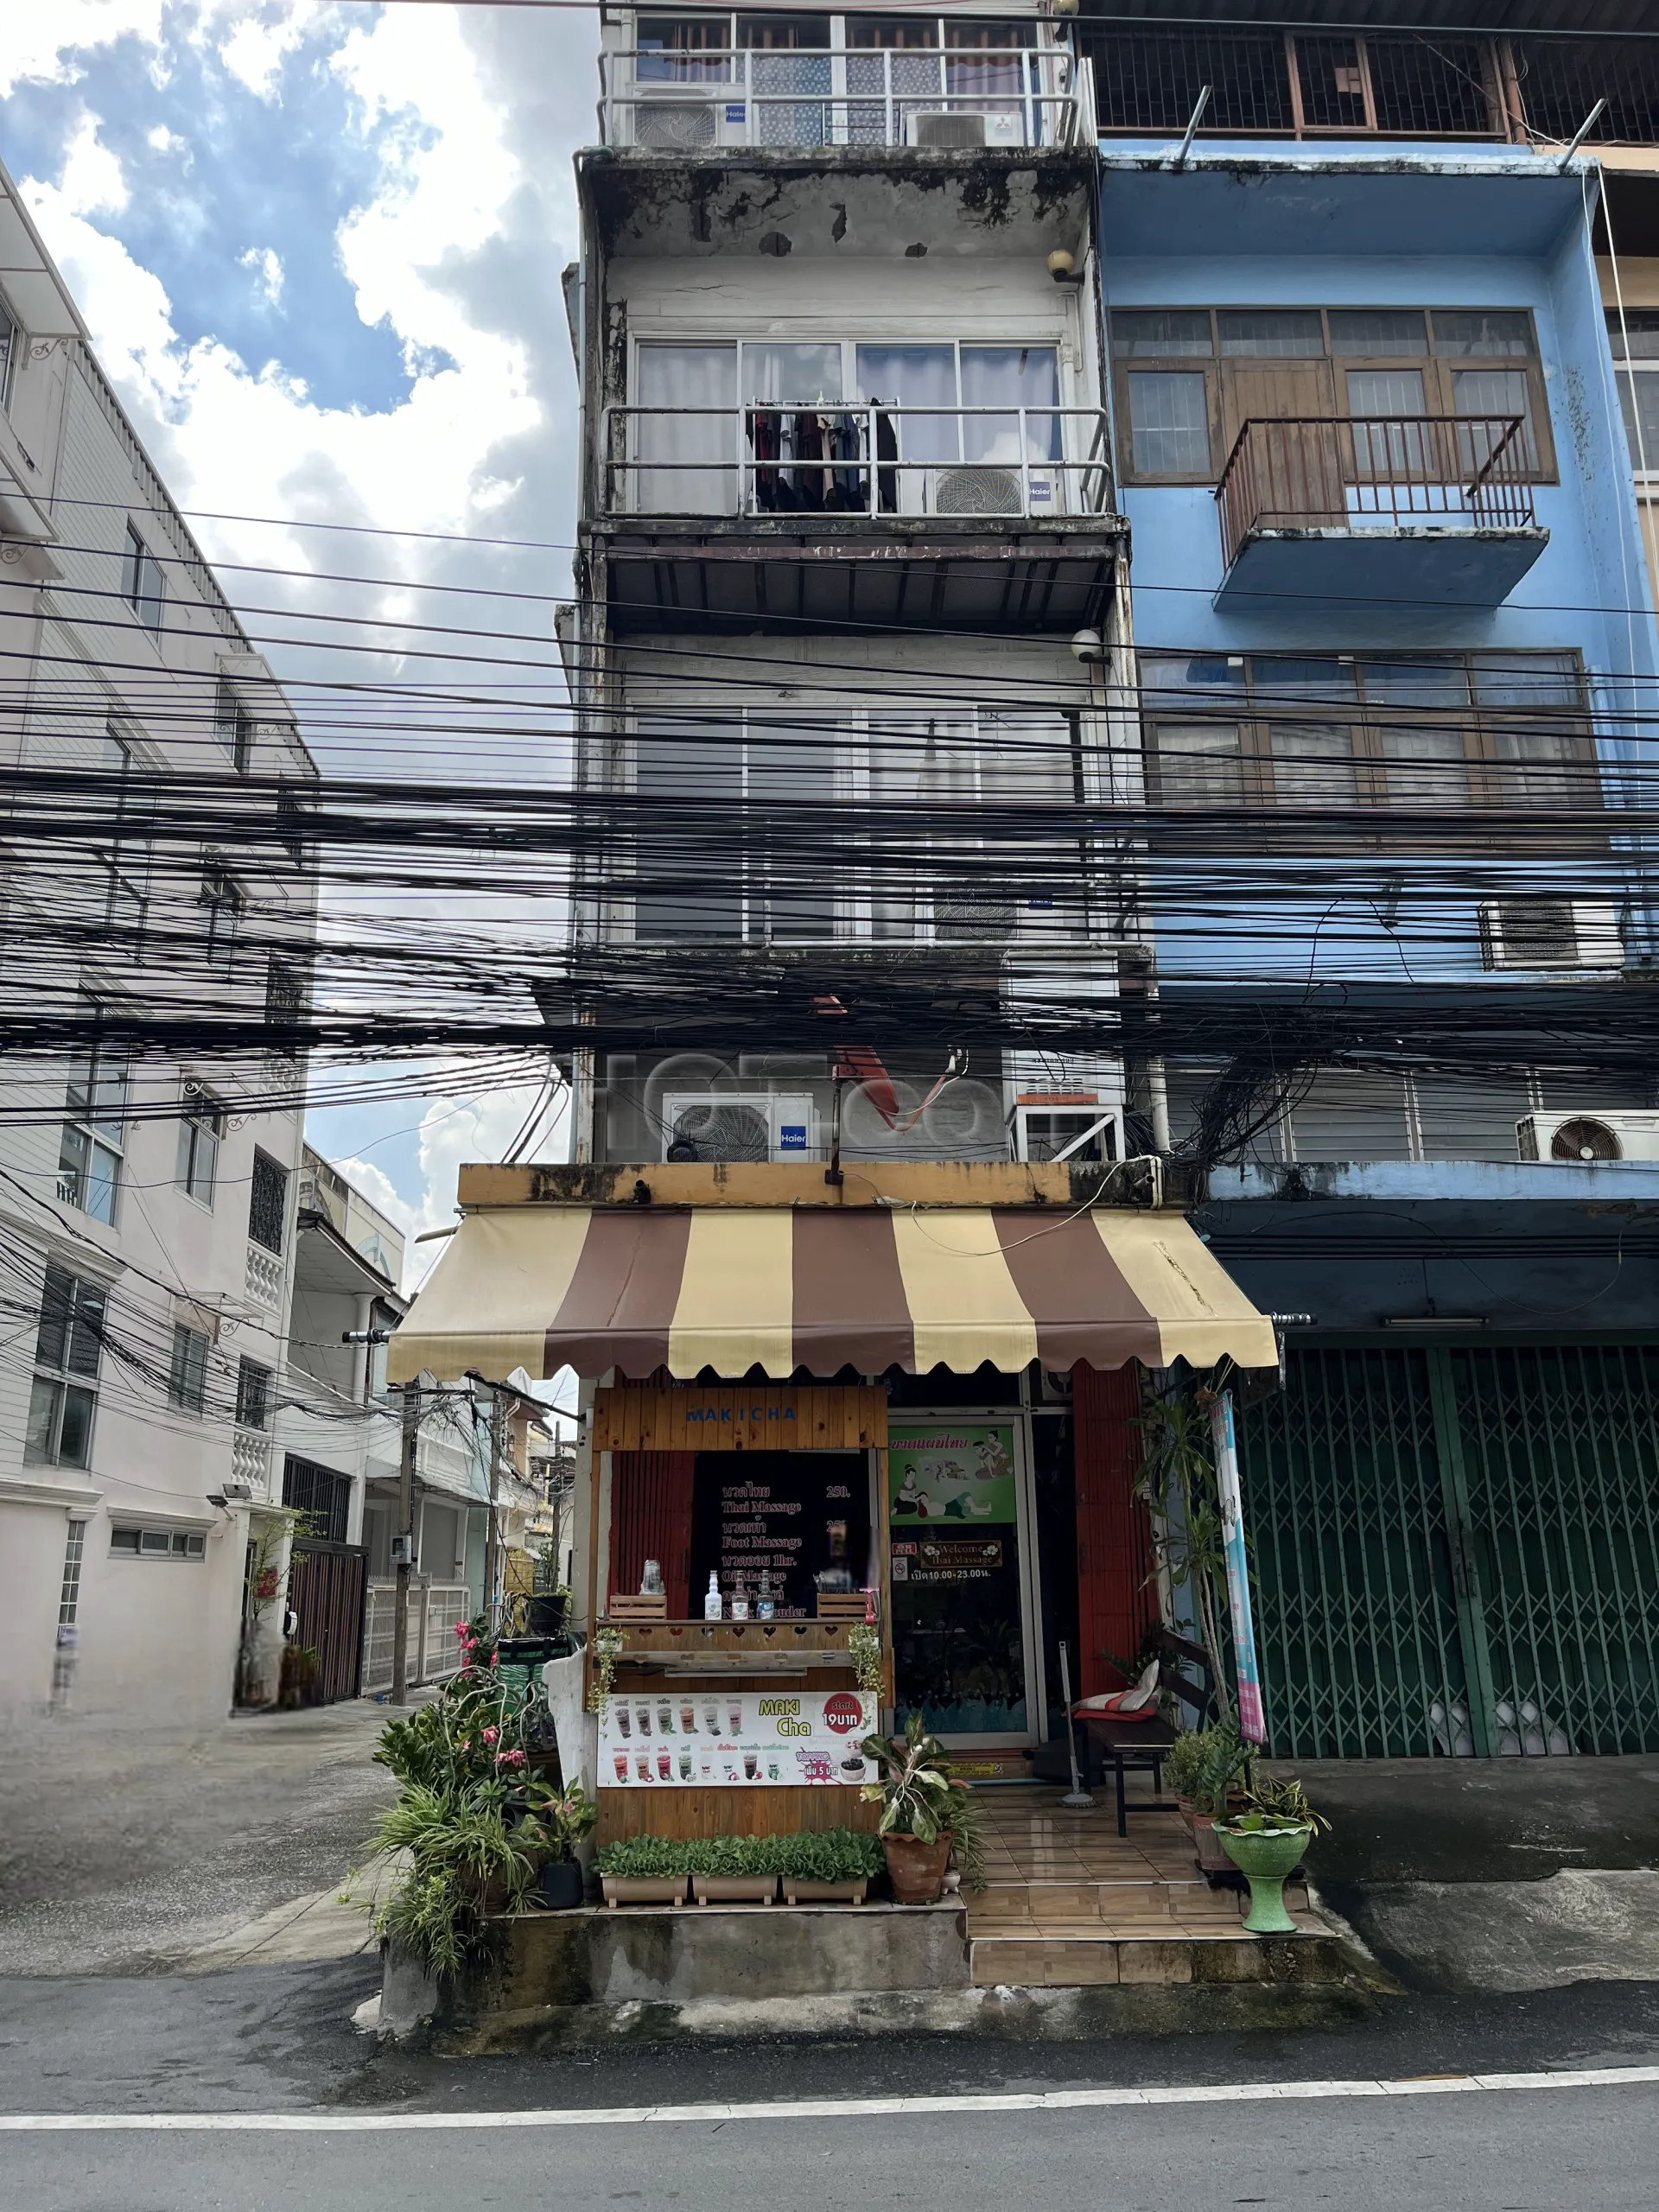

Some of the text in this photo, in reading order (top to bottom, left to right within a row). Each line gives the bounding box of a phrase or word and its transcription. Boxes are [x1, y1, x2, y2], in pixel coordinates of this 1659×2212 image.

[722, 1481, 850, 1498] นวดไทย 250.
[721, 1502, 802, 1515] Thai Massage
[722, 1515, 766, 1533] นวดเท้า
[721, 1536, 802, 1549] Foot Massage
[939, 1544, 983, 1554] Welcome
[721, 1554, 797, 1567] นวดออย 1hr.
[930, 1555, 994, 1566] Thai Massage
[759, 1699, 800, 1716] MAKI
[831, 1700, 853, 1710] start
[777, 1717, 811, 1736] Cha
[796, 1752, 830, 1761] TOPPING
[819, 1766, 824, 1775] 5
